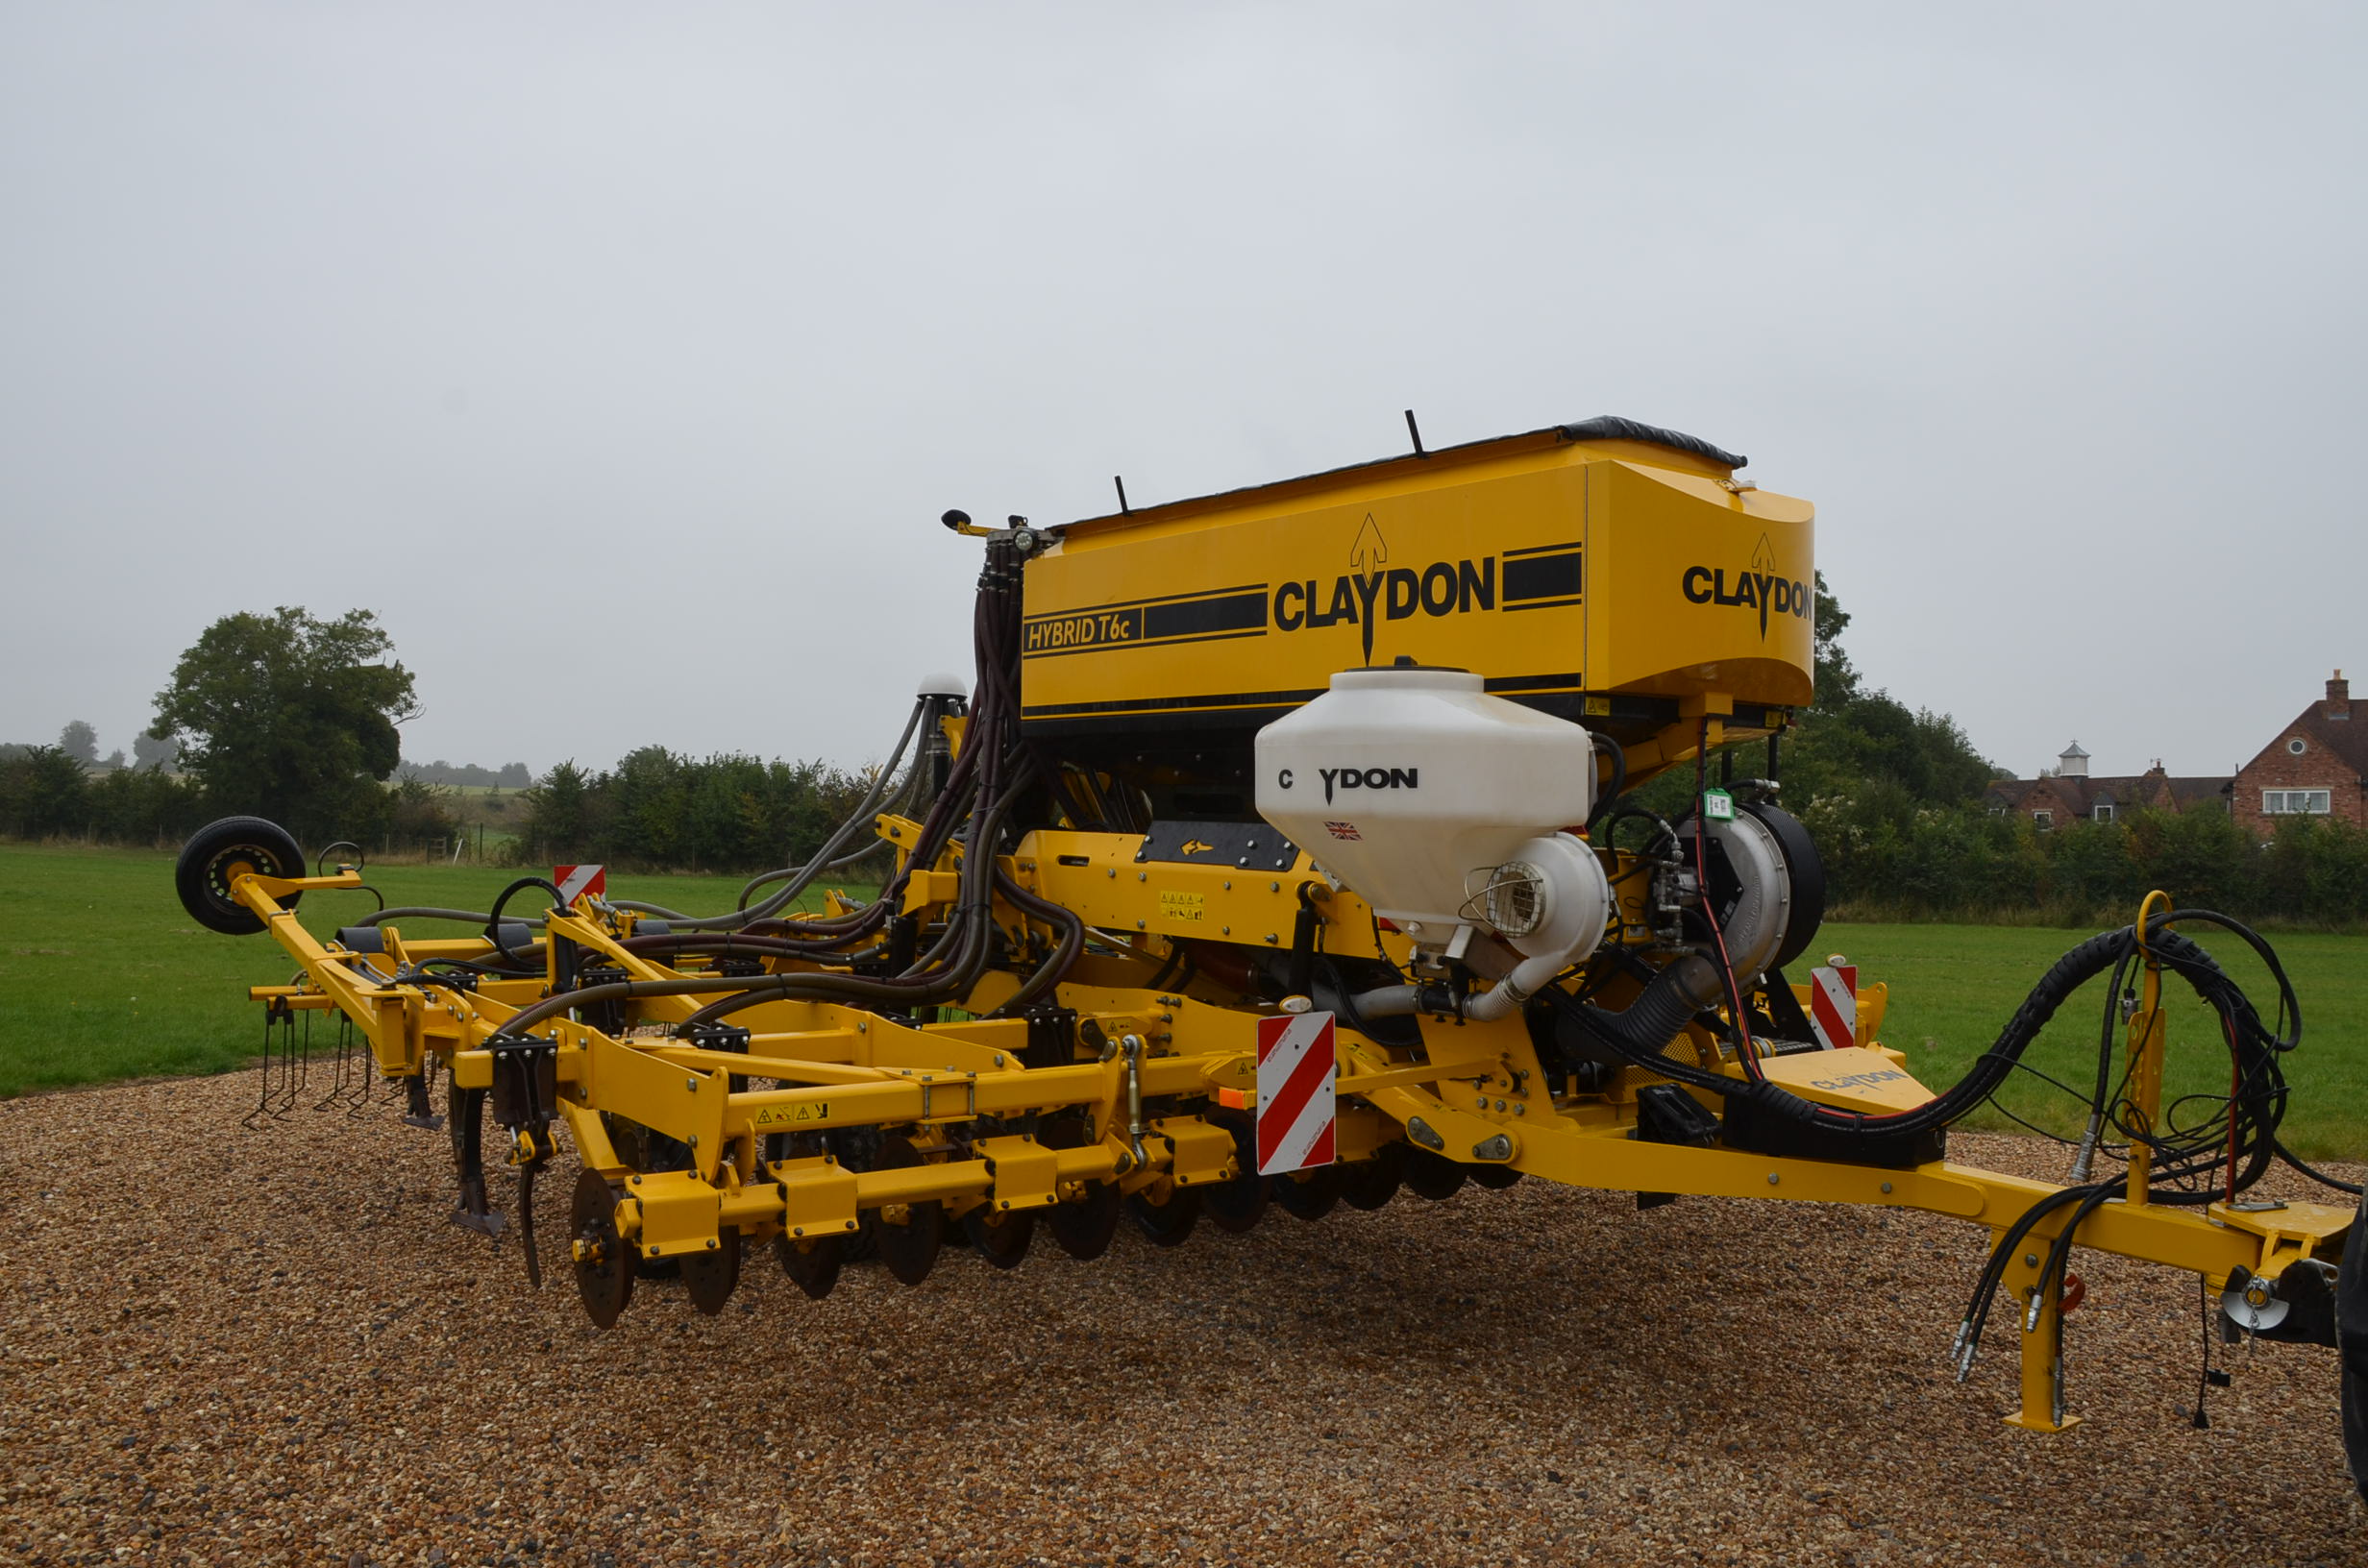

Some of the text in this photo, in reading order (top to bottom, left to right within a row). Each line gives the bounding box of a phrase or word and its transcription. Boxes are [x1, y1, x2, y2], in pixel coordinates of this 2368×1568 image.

[1028, 614, 1130, 649] HYBRID T6c
[1273, 556, 1495, 667] CLAYDON
[1682, 566, 1813, 644] CLAYDON
